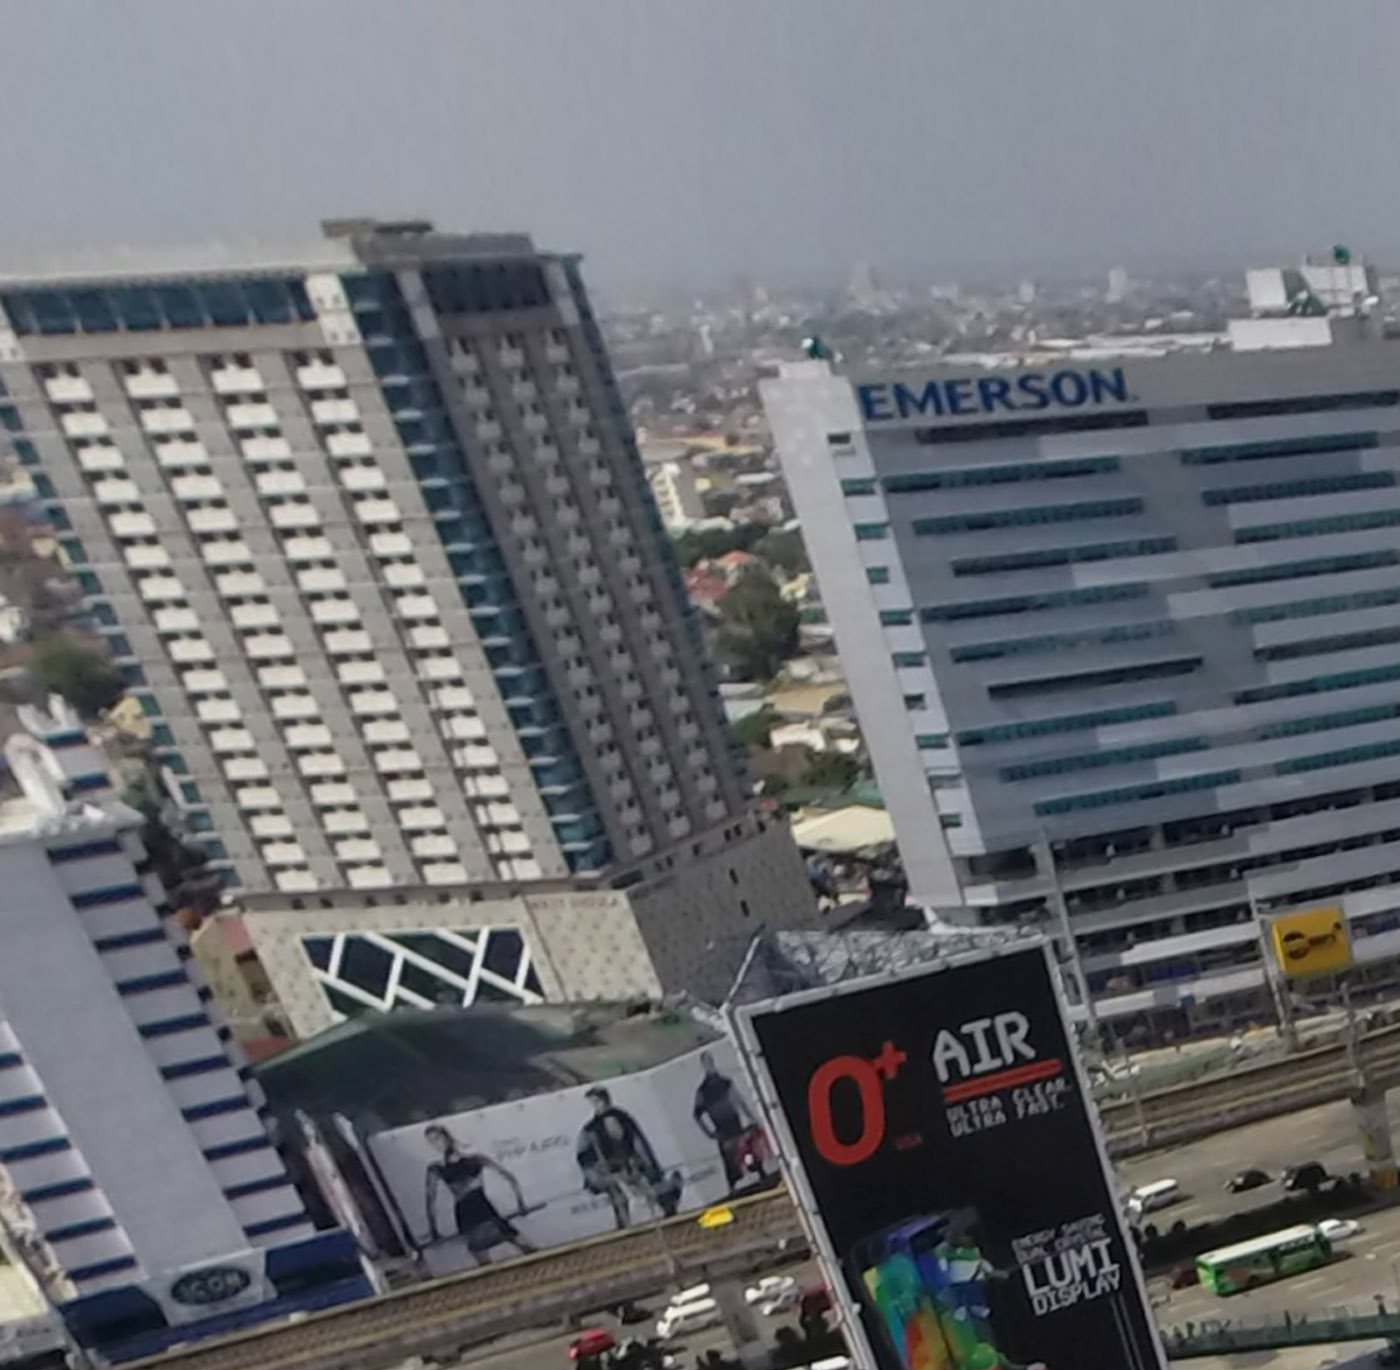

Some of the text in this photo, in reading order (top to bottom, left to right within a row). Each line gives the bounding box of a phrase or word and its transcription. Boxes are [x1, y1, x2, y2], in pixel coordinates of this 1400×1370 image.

[856, 366, 1129, 421] EMERSON
[932, 1011, 1037, 1083] AIR
[945, 1096, 1003, 1121] ULTRA
[950, 1111, 1007, 1138] ULTRA
[1022, 1237, 1121, 1298] LUMI
[1031, 1270, 1121, 1317] DISPLAY
